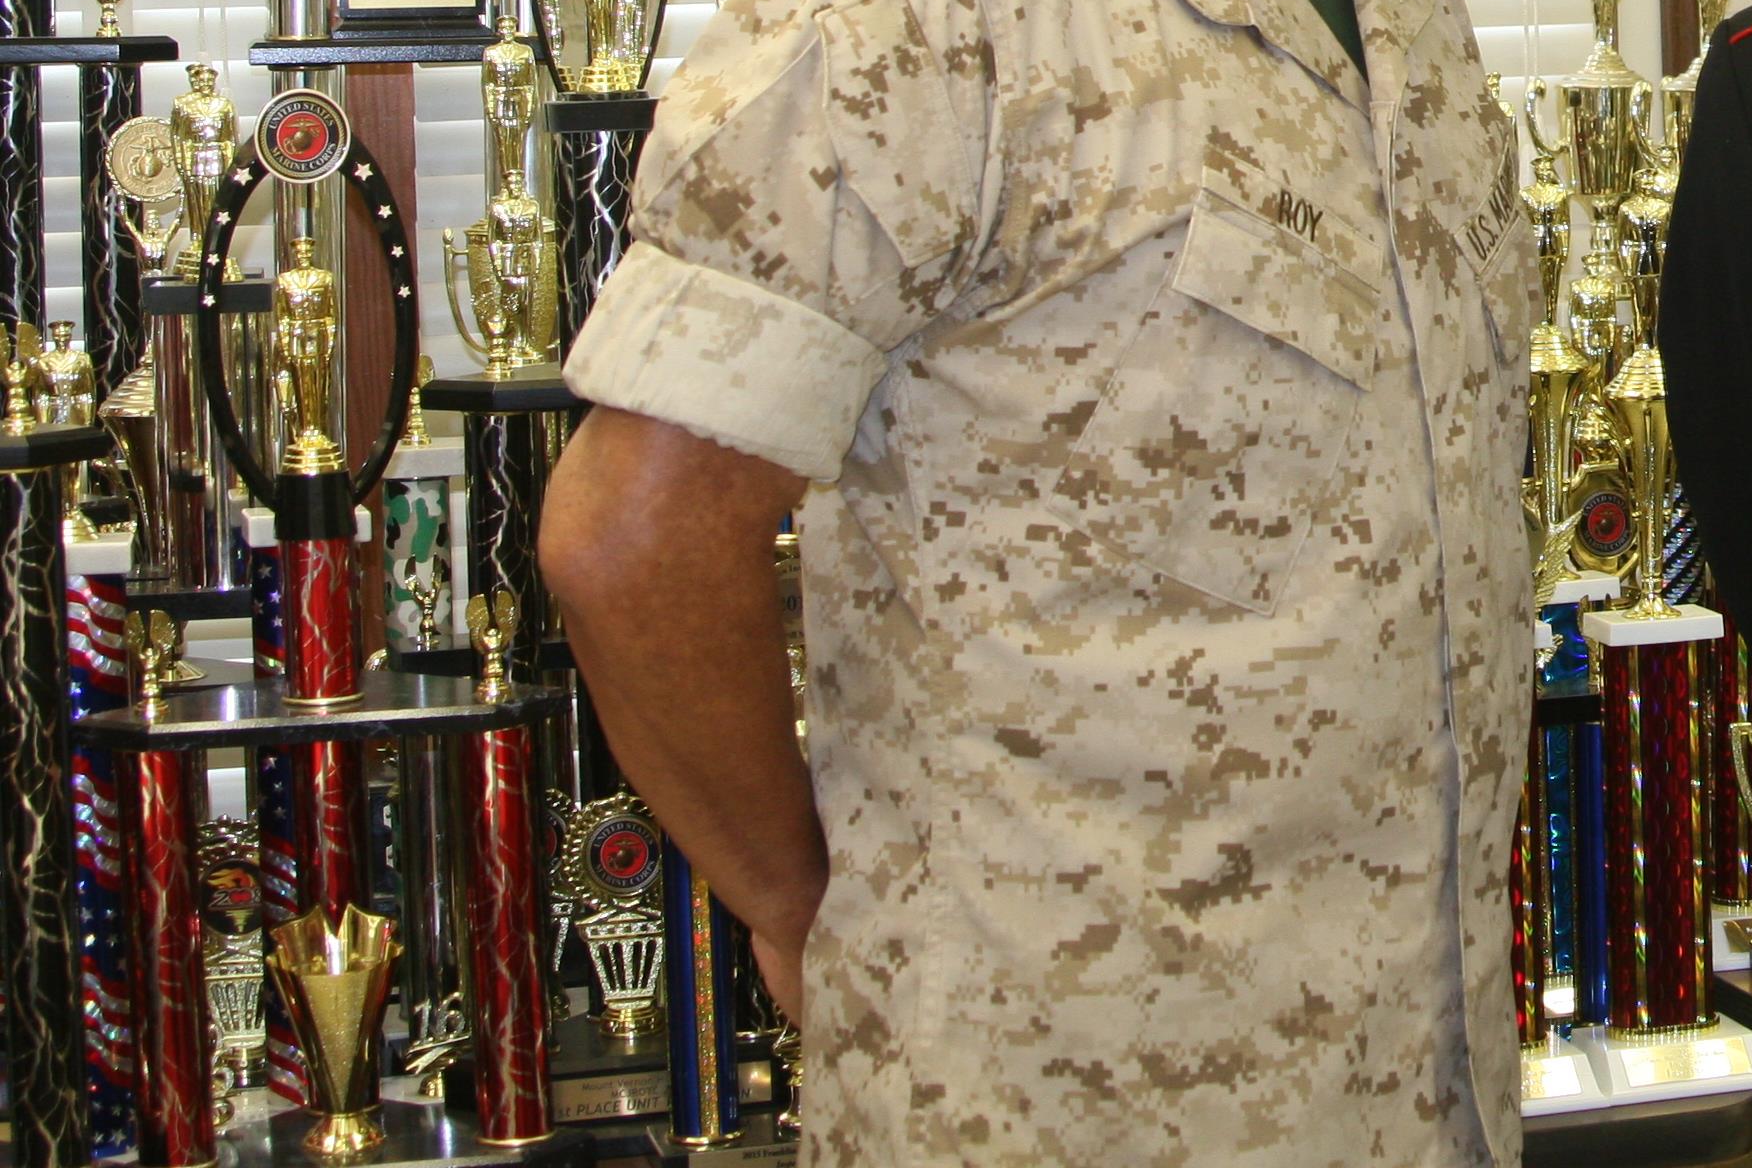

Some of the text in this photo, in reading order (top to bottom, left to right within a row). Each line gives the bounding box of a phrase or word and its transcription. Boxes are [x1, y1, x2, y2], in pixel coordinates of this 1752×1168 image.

[268, 102, 334, 130] UNITED STATES
[271, 143, 336, 171] MARINE CORPS
[1278, 189, 1325, 243] ROY
[1466, 213, 1499, 261] U.S.
[593, 823, 625, 847] UNITED
[576, 1100, 620, 1116] PLACE
[626, 1096, 659, 1111] UNIT
